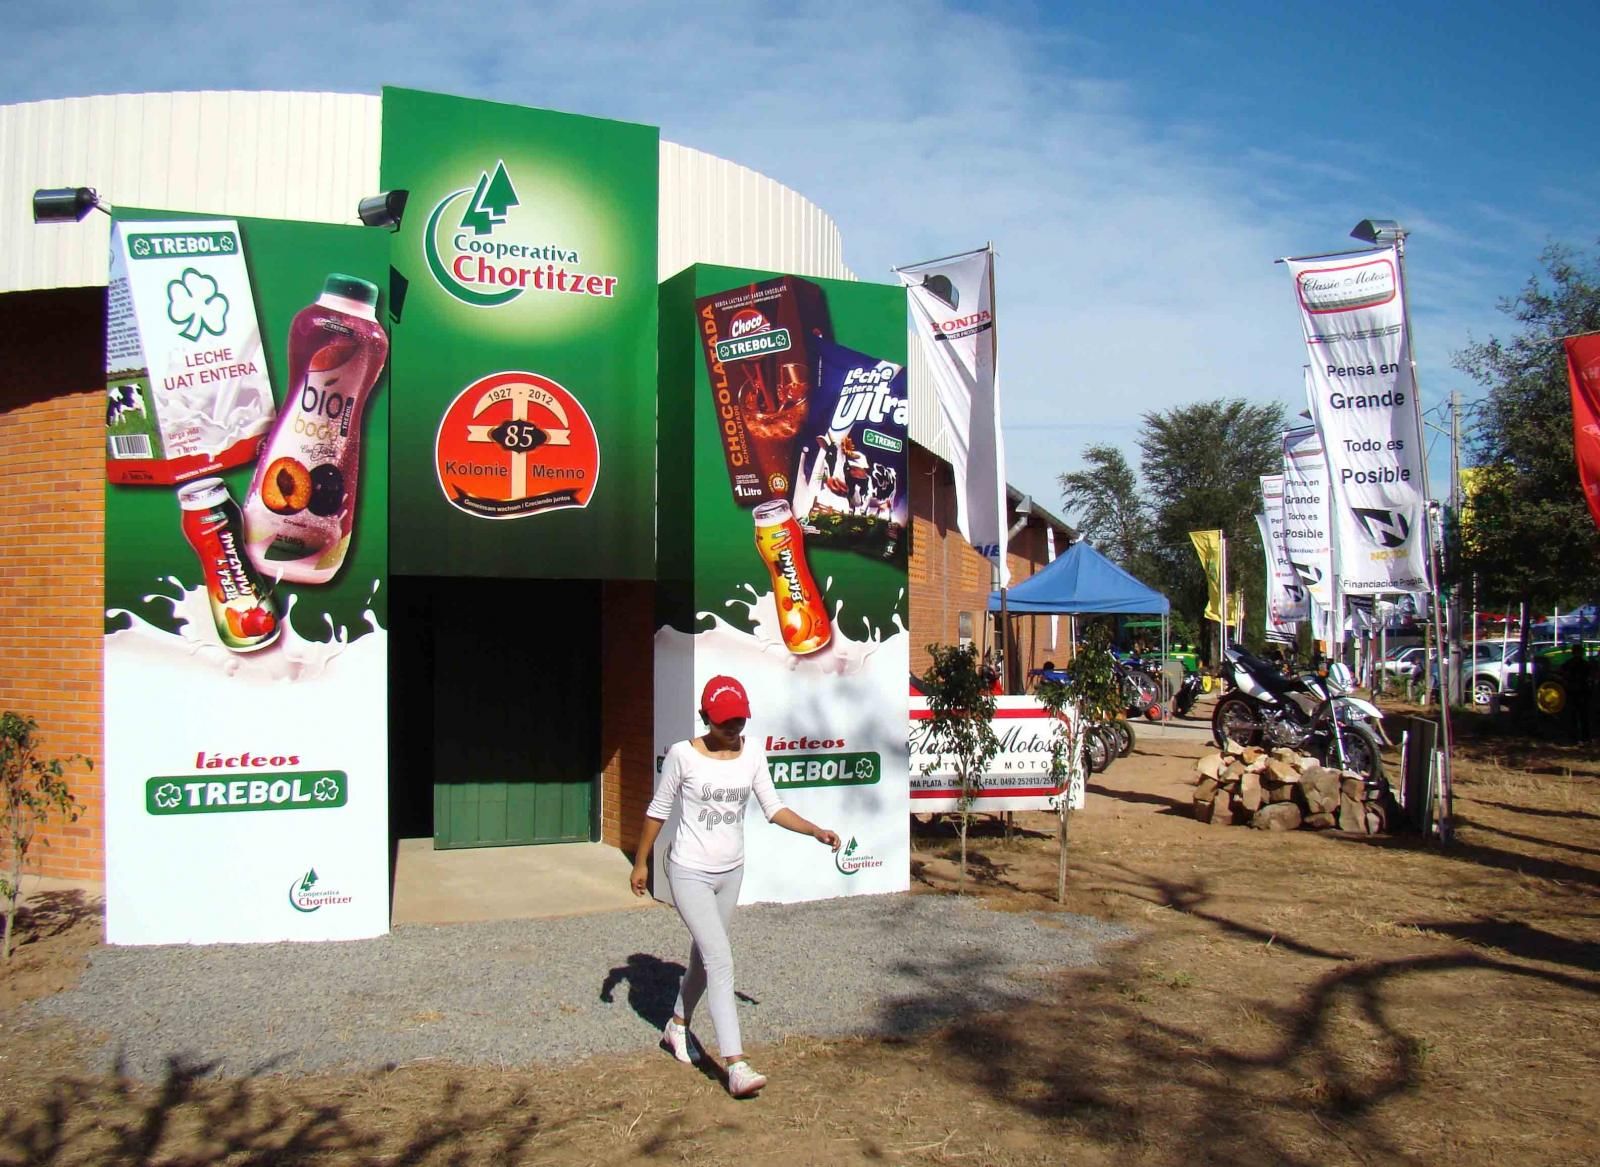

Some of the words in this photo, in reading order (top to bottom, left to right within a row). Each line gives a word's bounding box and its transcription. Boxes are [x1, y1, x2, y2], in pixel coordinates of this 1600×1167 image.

[150, 236, 221, 255] TREBOL
[453, 234, 579, 264] Cooperativa
[452, 254, 617, 297] Chortitzer
[732, 315, 763, 338] Choco
[729, 337, 776, 355] TREBOL
[185, 348, 233, 368] LECHE
[163, 373, 198, 391] UAT
[199, 362, 258, 385] ENTERA
[843, 367, 893, 386] Leche
[1380, 362, 1399, 374] en
[487, 388, 512, 403] 1927
[528, 389, 554, 406] 2012
[840, 384, 874, 396] Entera
[831, 381, 909, 431] Ultra
[1329, 390, 1405, 410] Grande
[504, 425, 535, 448] 85
[1343, 439, 1382, 452] Todo
[1386, 439, 1404, 451] es
[445, 461, 509, 477] Kolonie
[532, 464, 586, 480] Menno
[1341, 466, 1411, 485] Posible
[735, 484, 743, 497] 1
[743, 487, 762, 497] Litro
[1285, 495, 1320, 504] Grande
[1288, 512, 1306, 520] Todo
[1285, 528, 1324, 538] Posible
[781, 548, 803, 601] BANANA
[765, 735, 846, 752] lácteos
[195, 751, 302, 770] lácteos
[184, 779, 312, 807] TREBOL
[922, 779, 942, 788] PLATA
[701, 782, 751, 806] Sexy
[841, 860, 883, 870] Chortitzer
[298, 896, 353, 907] Chortitzer
